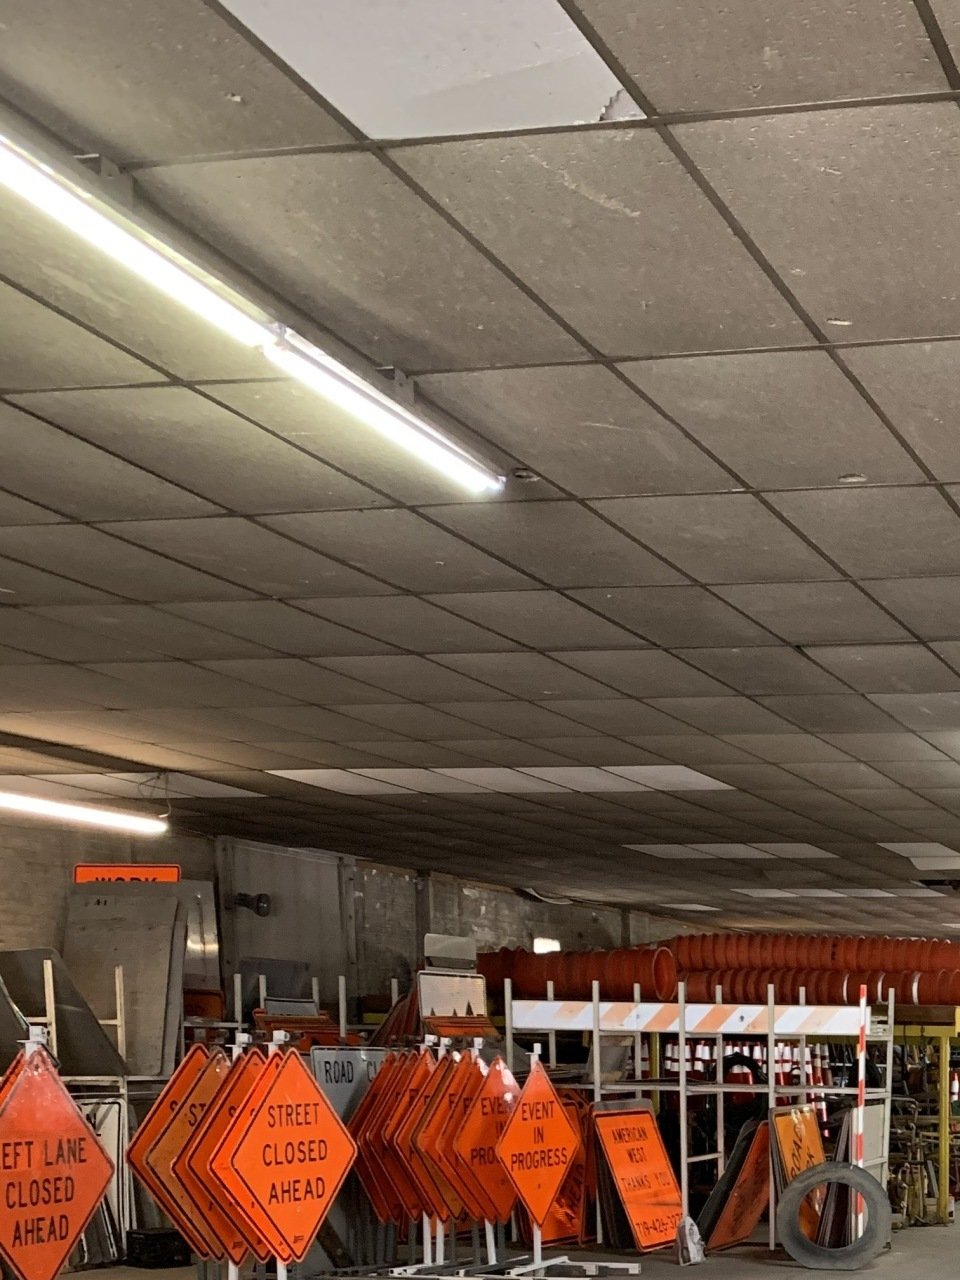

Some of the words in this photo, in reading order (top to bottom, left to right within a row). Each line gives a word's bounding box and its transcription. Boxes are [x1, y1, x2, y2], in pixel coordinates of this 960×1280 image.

[324, 1060, 354, 1083] ROAD
[267, 1102, 320, 1128] STREET
[521, 1100, 554, 1121] EVENT
[533, 1126, 544, 1144] IN
[611, 1127, 648, 1144] AMERICAN
[2, 1141, 34, 1170] EFT
[44, 1137, 87, 1167] LANE
[262, 1139, 328, 1167] CLOSED
[511, 1147, 568, 1171] PROGRESS
[626, 1147, 647, 1163] WEST
[6, 1176, 75, 1209] CLOSED
[268, 1177, 325, 1205] AHEAD
[12, 1214, 69, 1248] AHEAD
